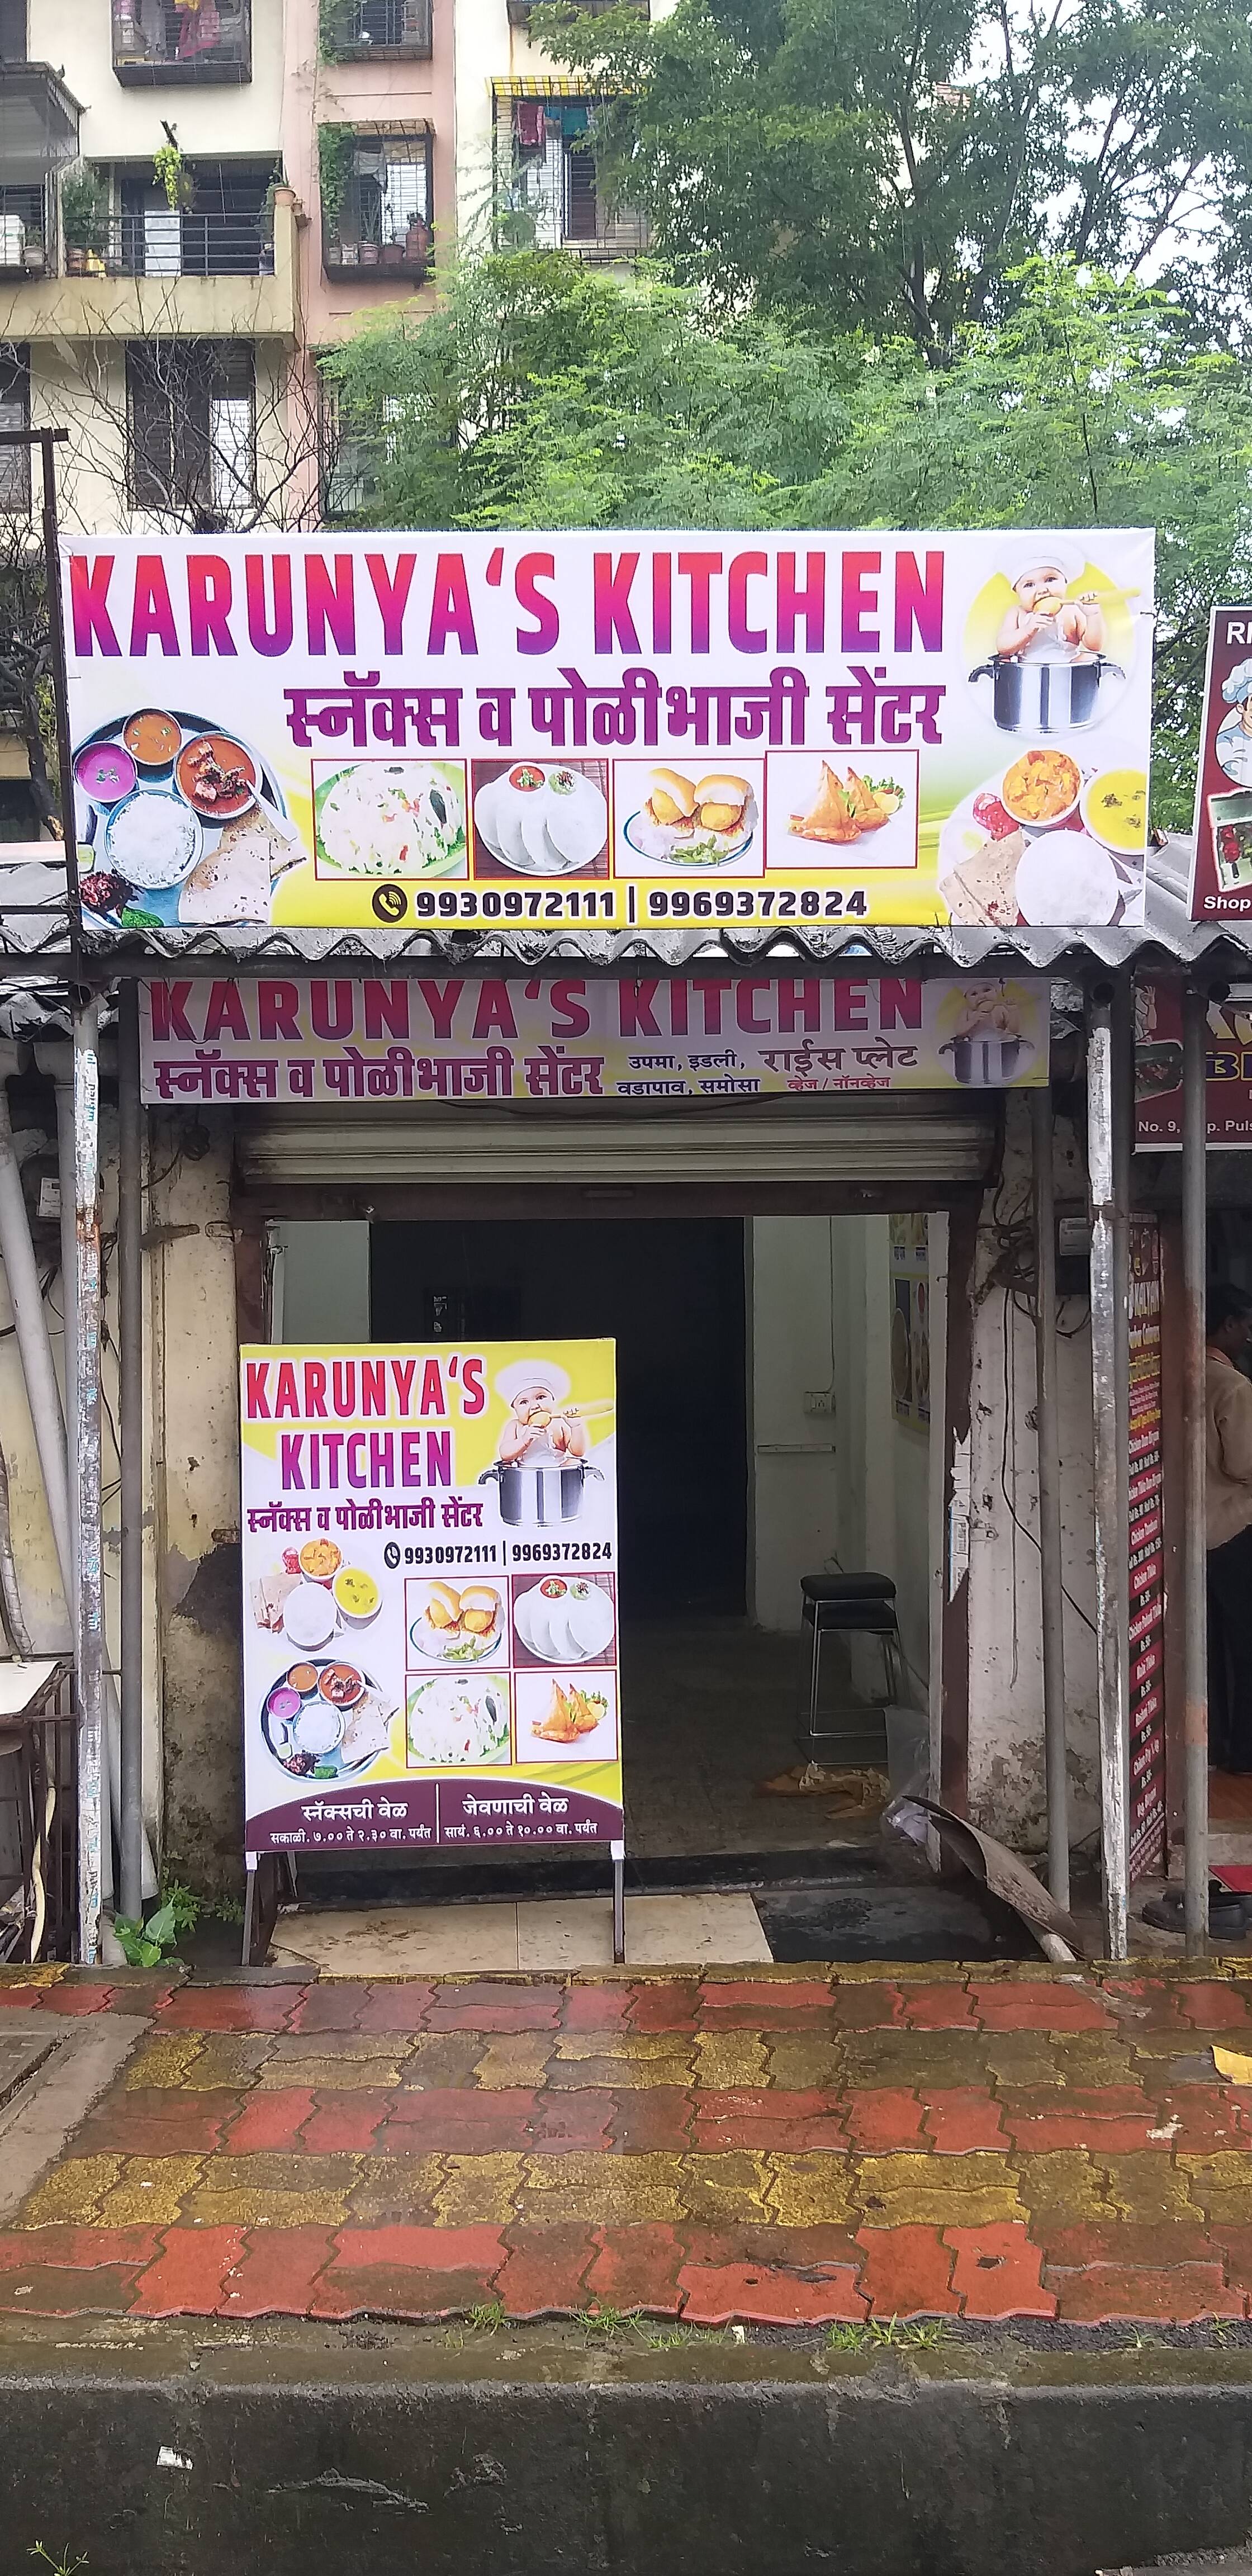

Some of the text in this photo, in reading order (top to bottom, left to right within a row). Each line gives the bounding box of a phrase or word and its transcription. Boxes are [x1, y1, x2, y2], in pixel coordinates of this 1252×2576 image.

[594, 550, 946, 655] KITCHEN
[284, 666, 946, 748] स्नॅक्स व पोळीभाजी सेंटर
[416, 890, 868, 917] 9930972111 9969372824
[1203, 896, 1251, 912] Shop
[619, 978, 923, 1038] KITCHEN
[628, 1049, 744, 1072] उपमा, इडली,
[758, 1036, 918, 1077] राईस प्लेट
[153, 1045, 605, 1099] स्नॅक्स व पोळीभाजी सेंटर
[617, 1074, 760, 1097] वडापाव, समोसा
[1138, 1121, 1163, 1132] No.
[1168, 1121, 1180, 1133] 9,
[281, 1431, 451, 1490] KITCHEN
[247, 1497, 483, 1532] स्नॅक्स व पोळीभाजी सेंटर
[405, 1542, 612, 1565] 9930972111 9969372824
[301, 1796, 408, 1821] स्नॅक्सची वेळ
[462, 1791, 569, 1816] जेवणाची वेळ
[269, 1828, 310, 1844] सकाळी.
[345, 1826, 354, 1841] ते
[389, 1830, 406, 1840] वा.
[409, 1824, 432, 1840] पर्यंत
[444, 1824, 471, 1839] सायं.
[505, 1821, 514, 1836] ते
[556, 1824, 573, 1835] वा.
[574, 1819, 598, 1835] पर्यंत
